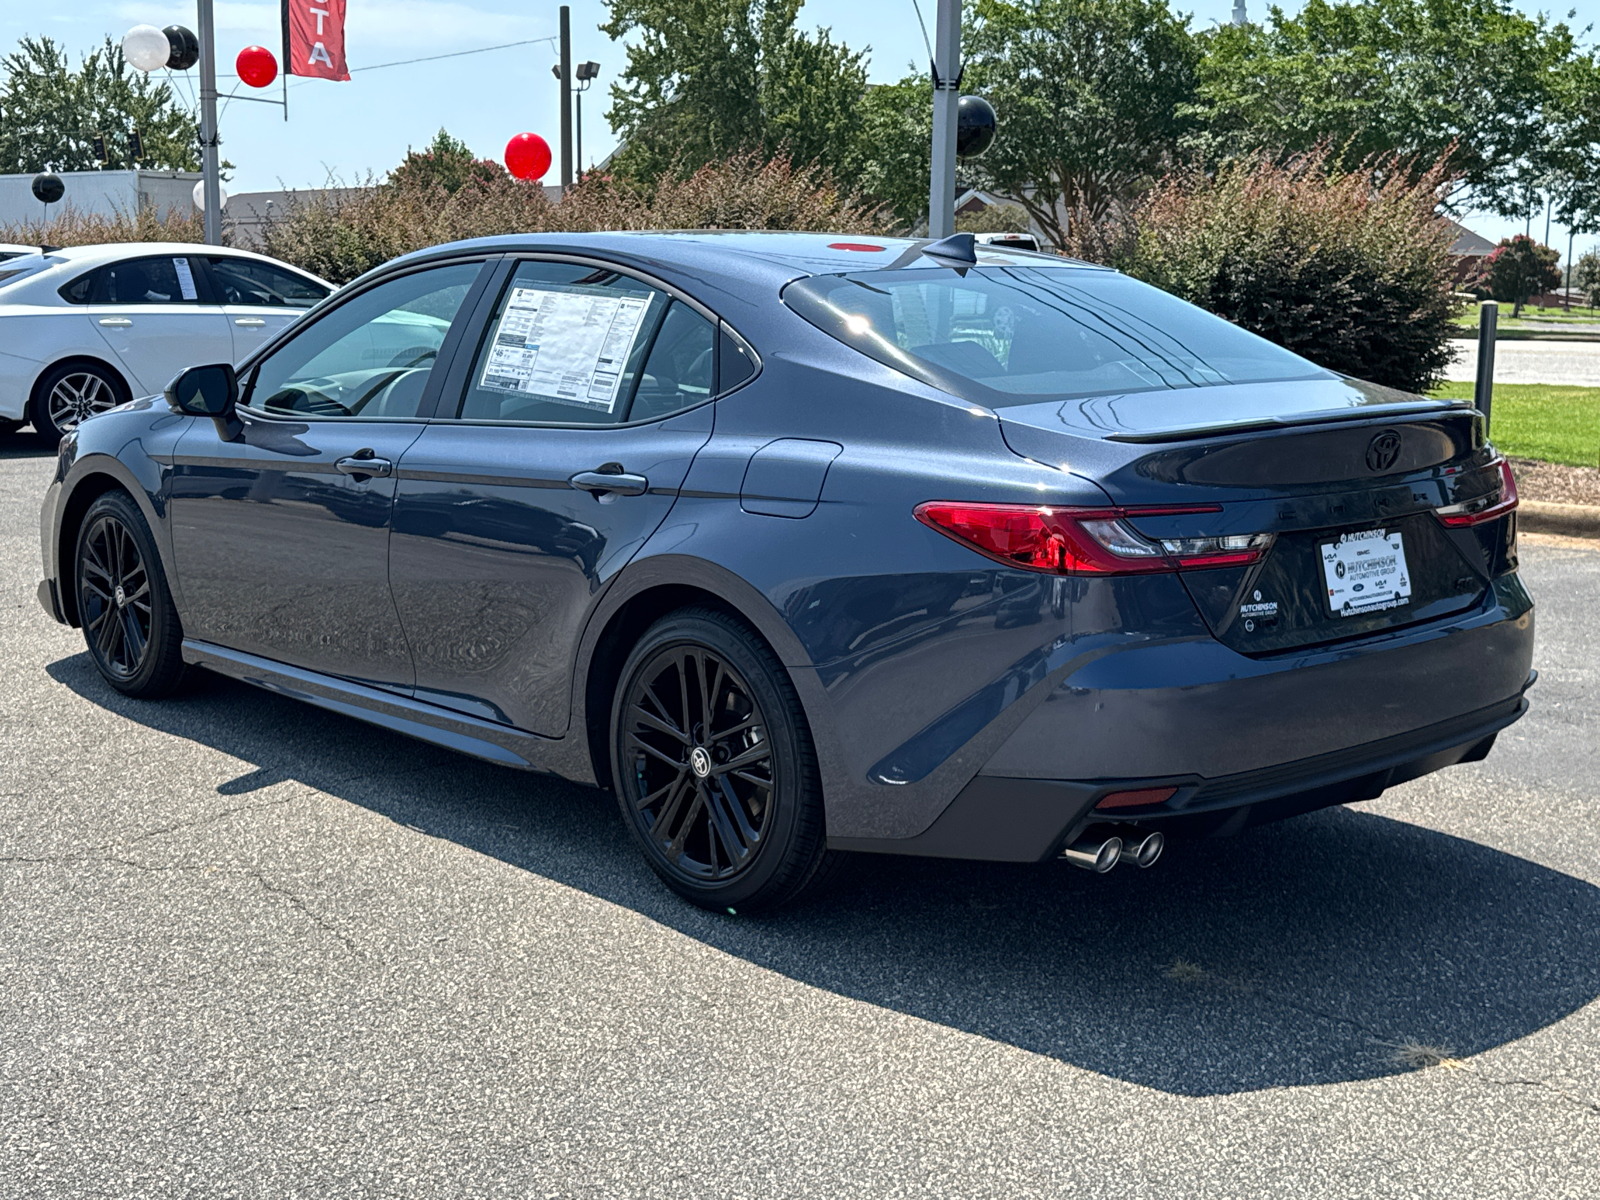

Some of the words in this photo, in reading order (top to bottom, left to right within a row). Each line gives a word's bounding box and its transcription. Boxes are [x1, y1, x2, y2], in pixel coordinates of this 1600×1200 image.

[307, 0, 334, 69] TA
[1350, 569, 1380, 581] AUTOMOTIVE
[1380, 566, 1396, 577] GROUP
[1240, 602, 1278, 613] HUTCHINSON
